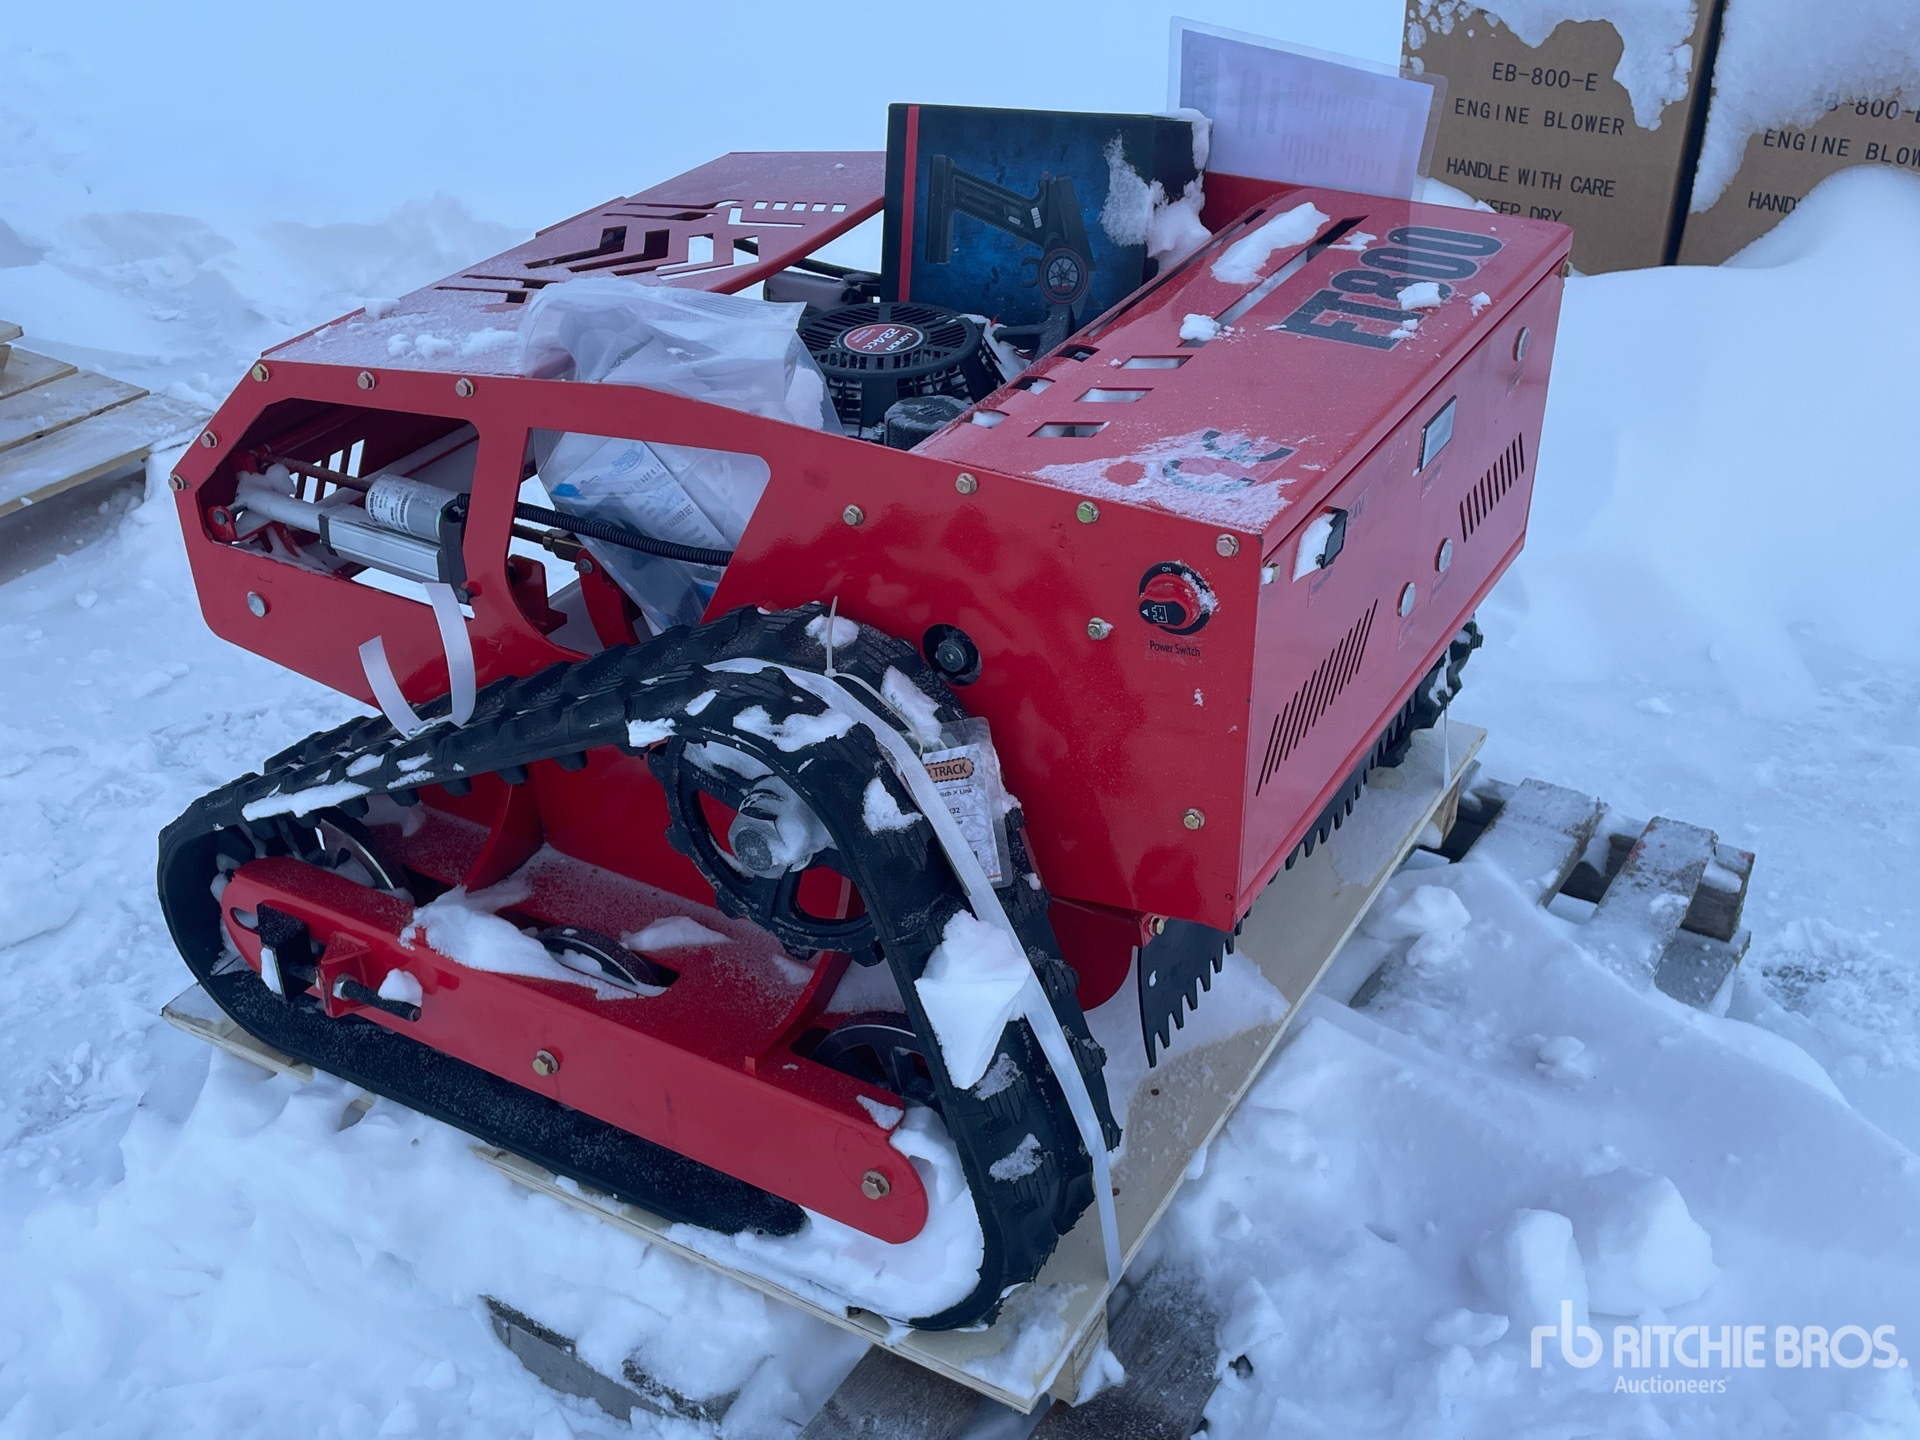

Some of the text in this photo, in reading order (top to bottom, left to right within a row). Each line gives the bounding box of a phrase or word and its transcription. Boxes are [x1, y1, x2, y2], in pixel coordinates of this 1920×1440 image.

[1492, 61, 1598, 92] EB-800-E
[1454, 97, 1626, 136] ENGINE BLOWER
[1763, 129, 1851, 157] ENGINE
[1446, 157, 1616, 198] HANDLE WITH CARE
[1529, 206, 1563, 222] DRY
[1748, 190, 1802, 214] HAND
[1279, 226, 1503, 351] FT800
[1149, 640, 1201, 657] Power Switch
[932, 763, 967, 777] TRACK
